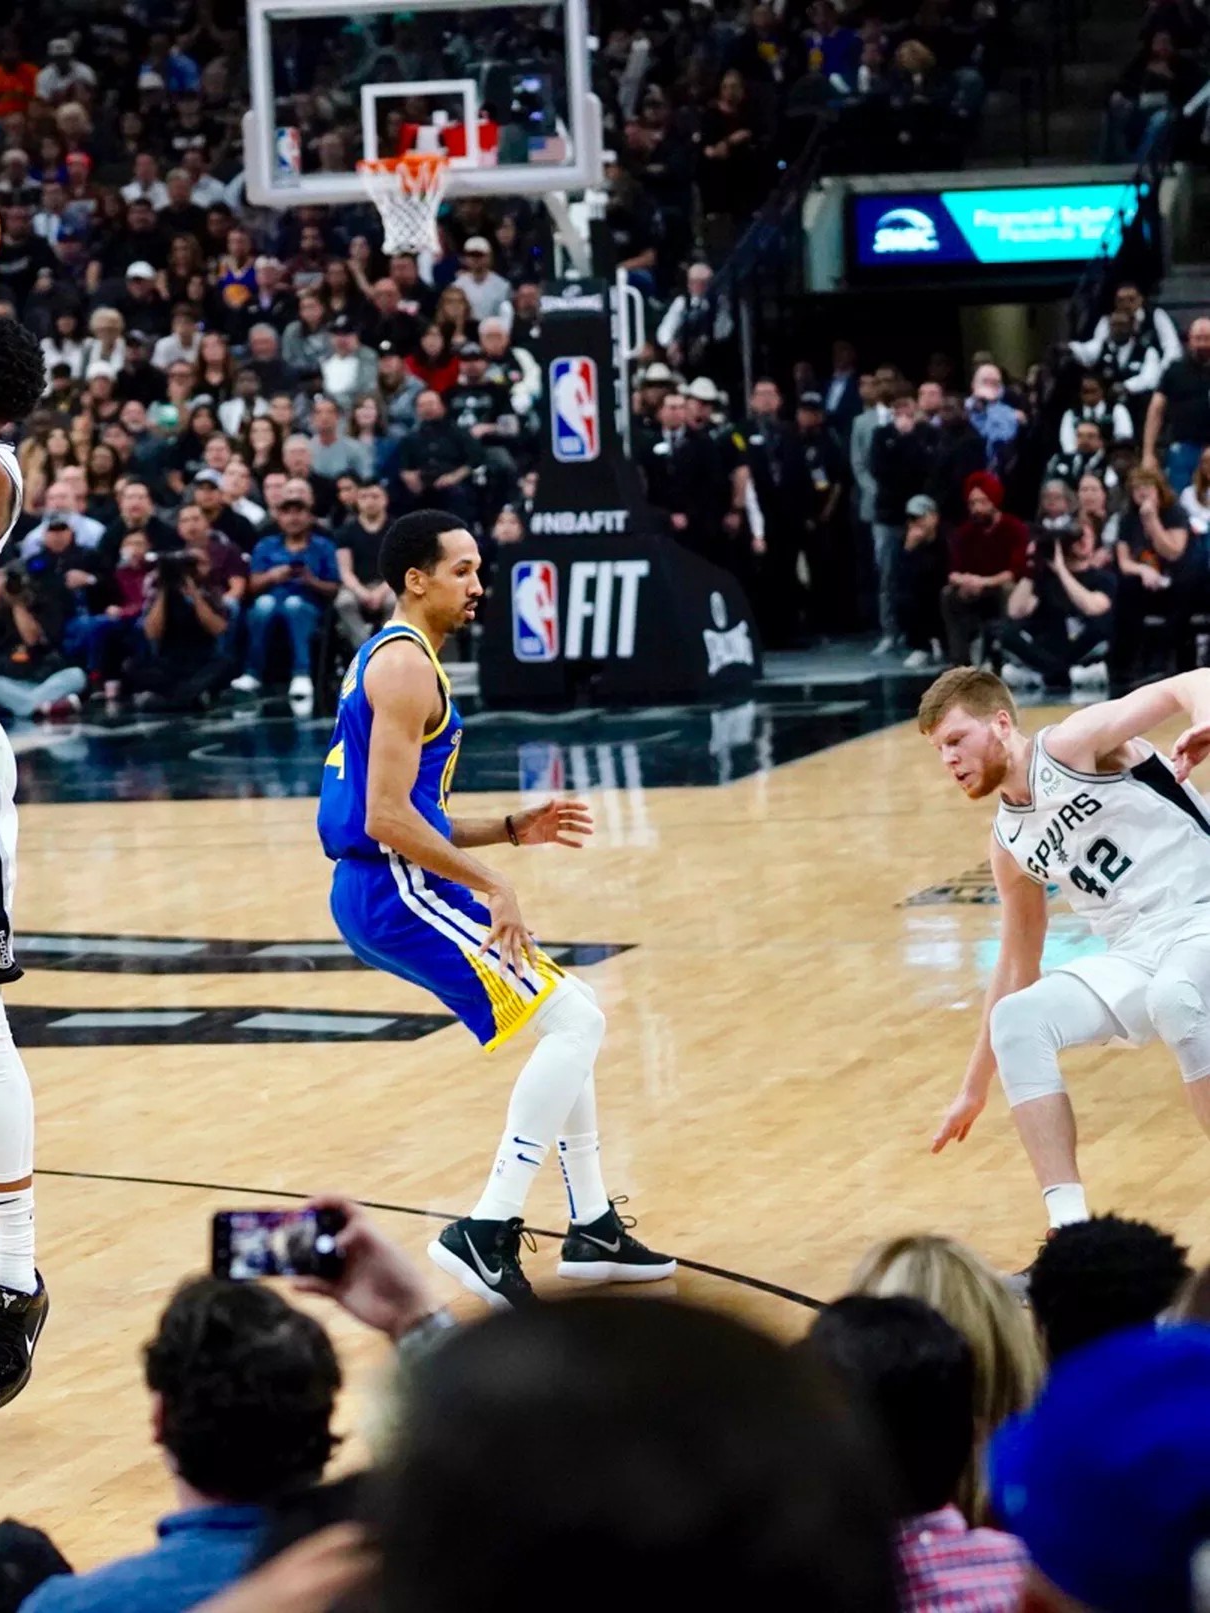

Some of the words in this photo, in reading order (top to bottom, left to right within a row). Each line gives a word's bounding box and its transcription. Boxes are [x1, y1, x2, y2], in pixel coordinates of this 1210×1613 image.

[531, 510, 629, 534] #NBAFIT
[564, 560, 650, 660] FIT
[1027, 792, 1103, 879] SPURS
[1069, 837, 1133, 899] 42
